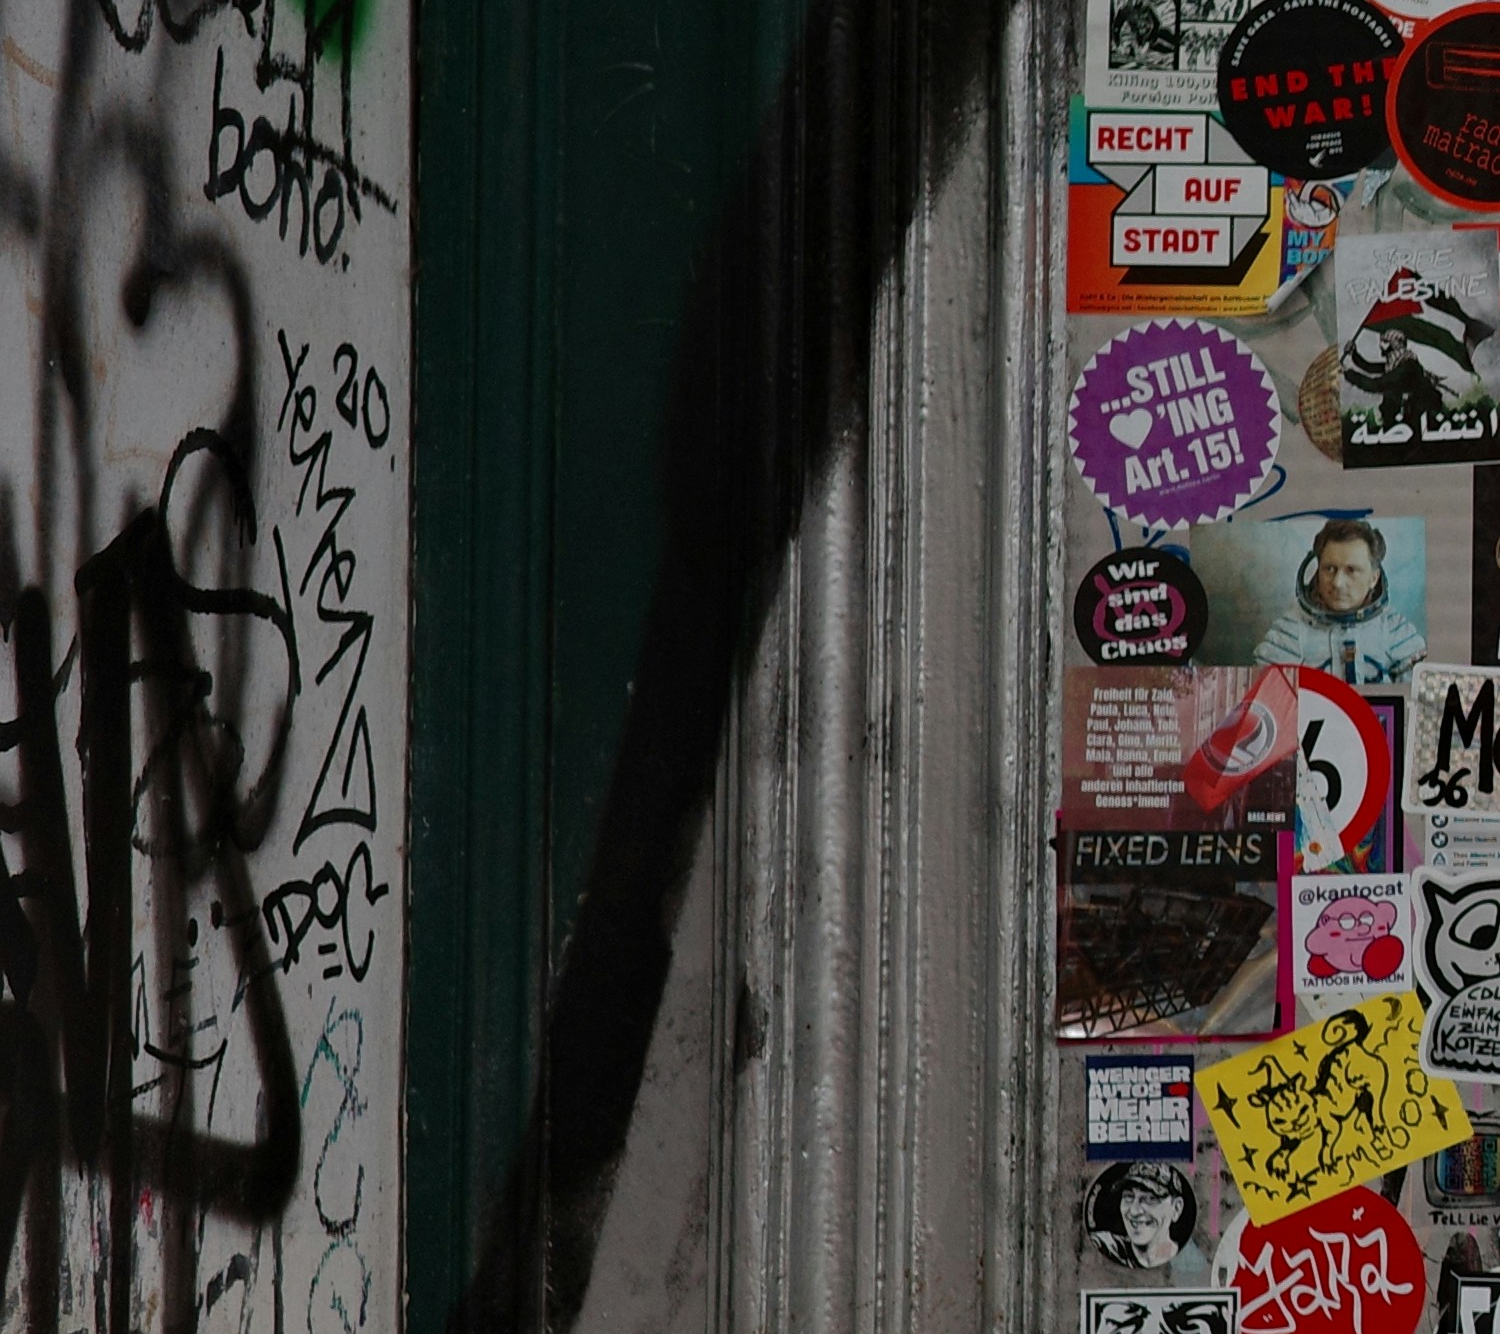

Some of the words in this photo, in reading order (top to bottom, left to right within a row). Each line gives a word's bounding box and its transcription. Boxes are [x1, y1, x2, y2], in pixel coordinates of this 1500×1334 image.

[1098, 126, 1193, 151] RECHT
[1184, 178, 1241, 203] AUF
[1123, 229, 1220, 252] STADT
[1076, 835, 1169, 866] FIXED
[1180, 833, 1263, 866] LENS
[1298, 879, 1405, 906] @kantocat
[1089, 1065, 1192, 1085] WENIGER
[1089, 1084, 1162, 1100] AUTOS
[1089, 1100, 1190, 1121] MEHR
[1088, 1118, 1189, 1145] BERLIN
